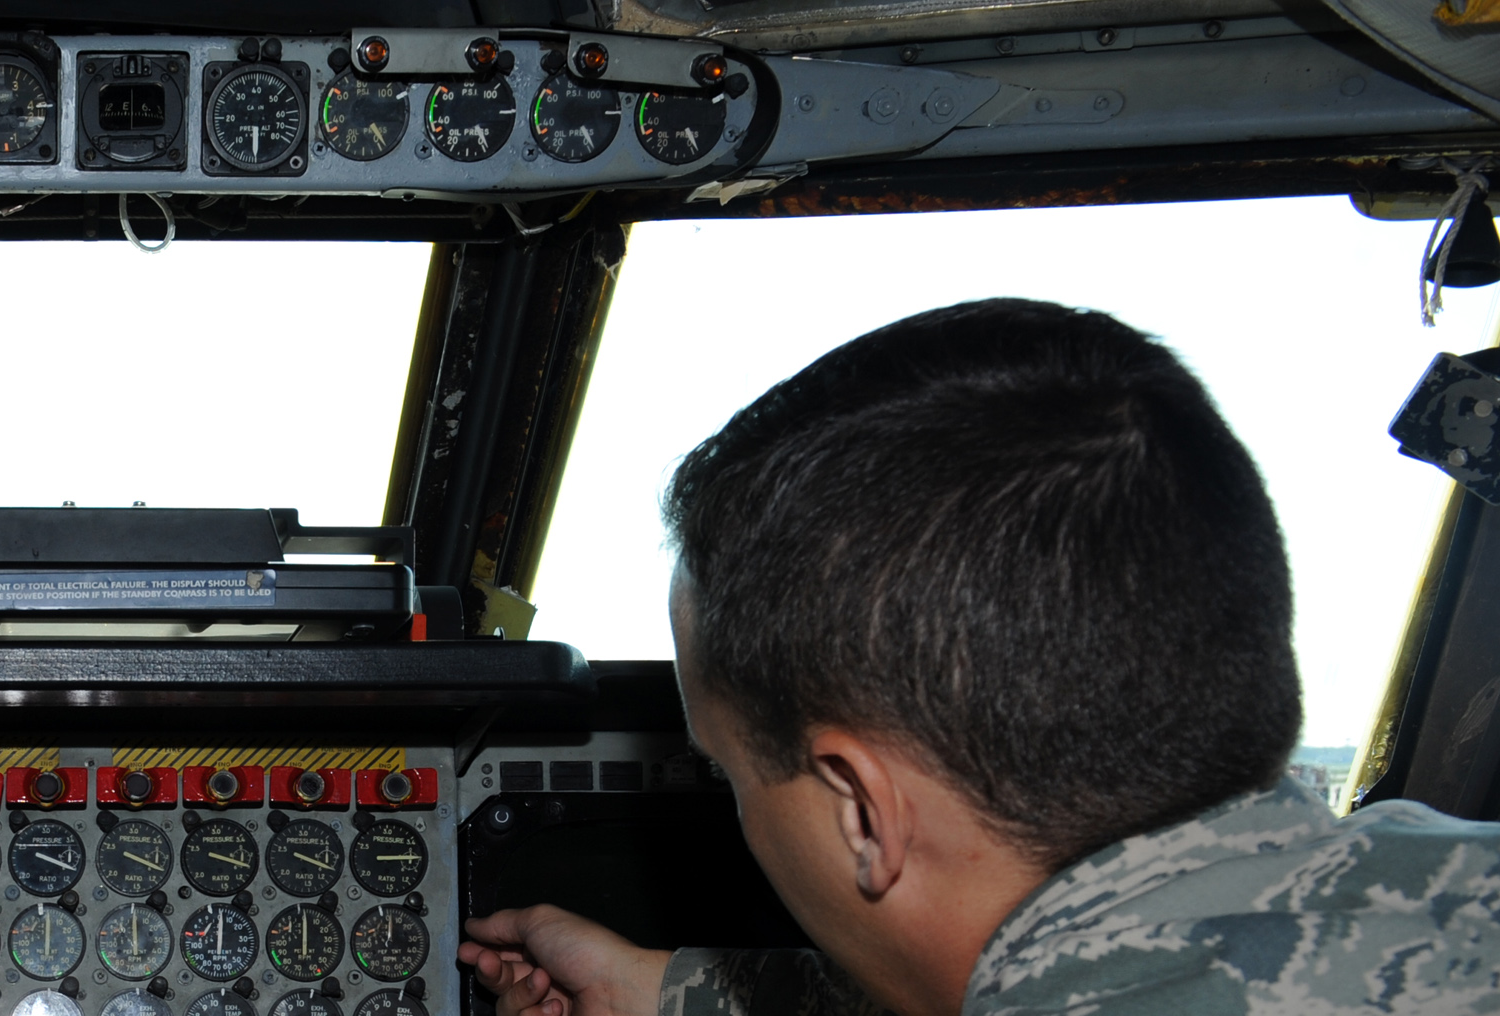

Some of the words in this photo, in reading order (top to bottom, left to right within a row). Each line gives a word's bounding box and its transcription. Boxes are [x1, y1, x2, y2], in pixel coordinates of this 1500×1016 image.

[123, 102, 129, 110] E
[449, 128, 461, 136] OIL
[47, 591, 89, 599] POSITION
[121, 590, 161, 598] STANDBY
